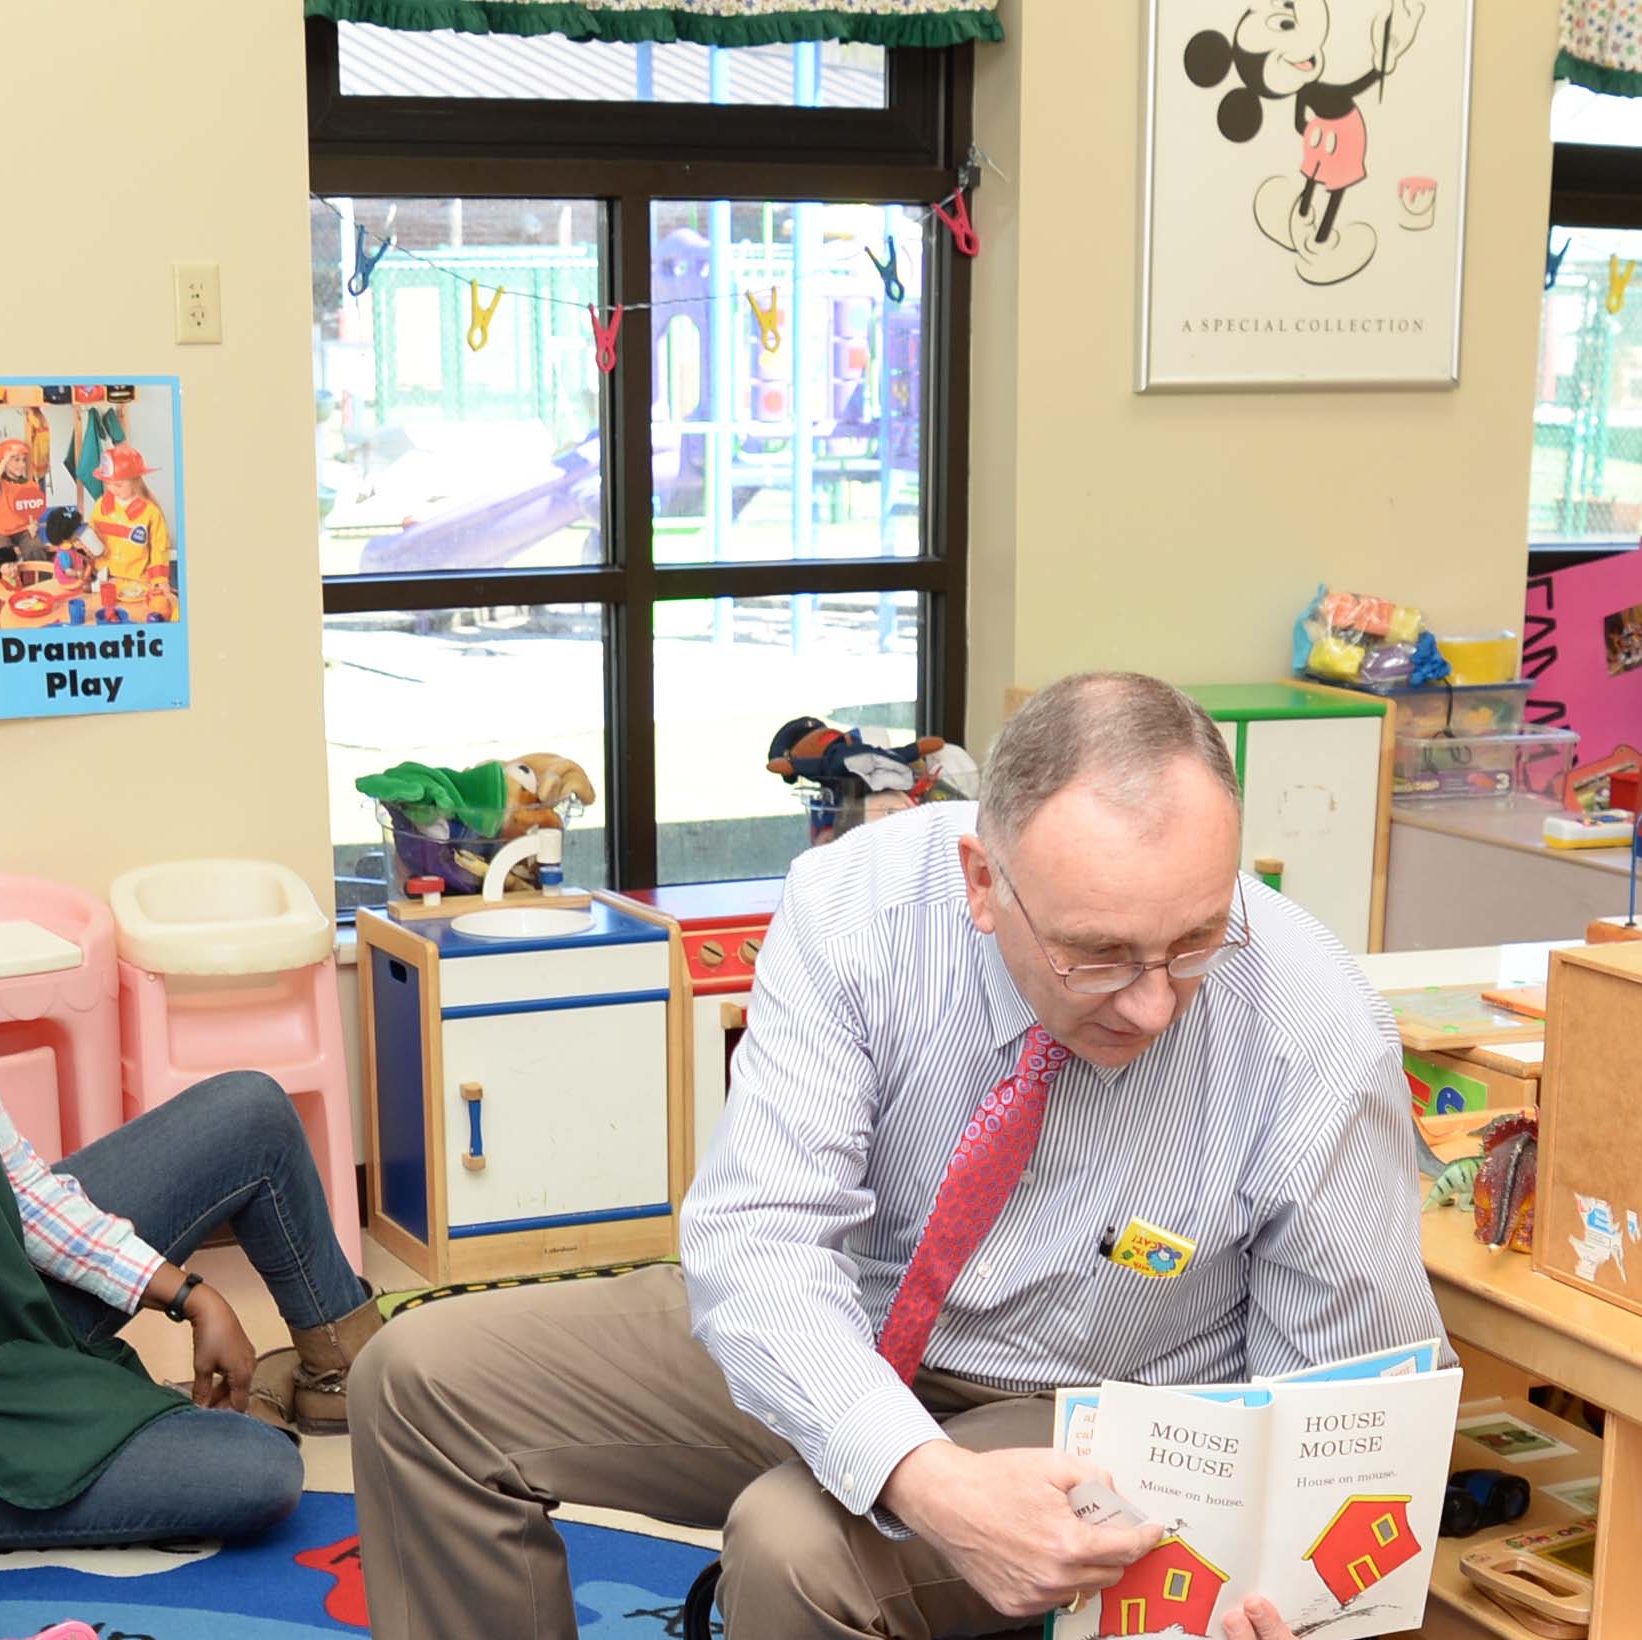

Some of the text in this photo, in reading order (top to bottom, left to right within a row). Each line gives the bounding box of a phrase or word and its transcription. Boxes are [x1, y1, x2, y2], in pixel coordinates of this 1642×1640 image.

[1181, 318, 1426, 333] A SPECIAL COLLECTION
[15, 498, 44, 511] STOP
[1, 630, 164, 664] Dramatic
[46, 669, 123, 702] Play
[1305, 1411, 1386, 1433] HOUSE
[1150, 1421, 1239, 1454] MOUSE
[1299, 1436, 1382, 1459] MOUSE
[1149, 1446, 1234, 1478] HOUSE
[1297, 1470, 1398, 1488] House on mouse.
[1140, 1479, 1245, 1508] Mouse on house.
